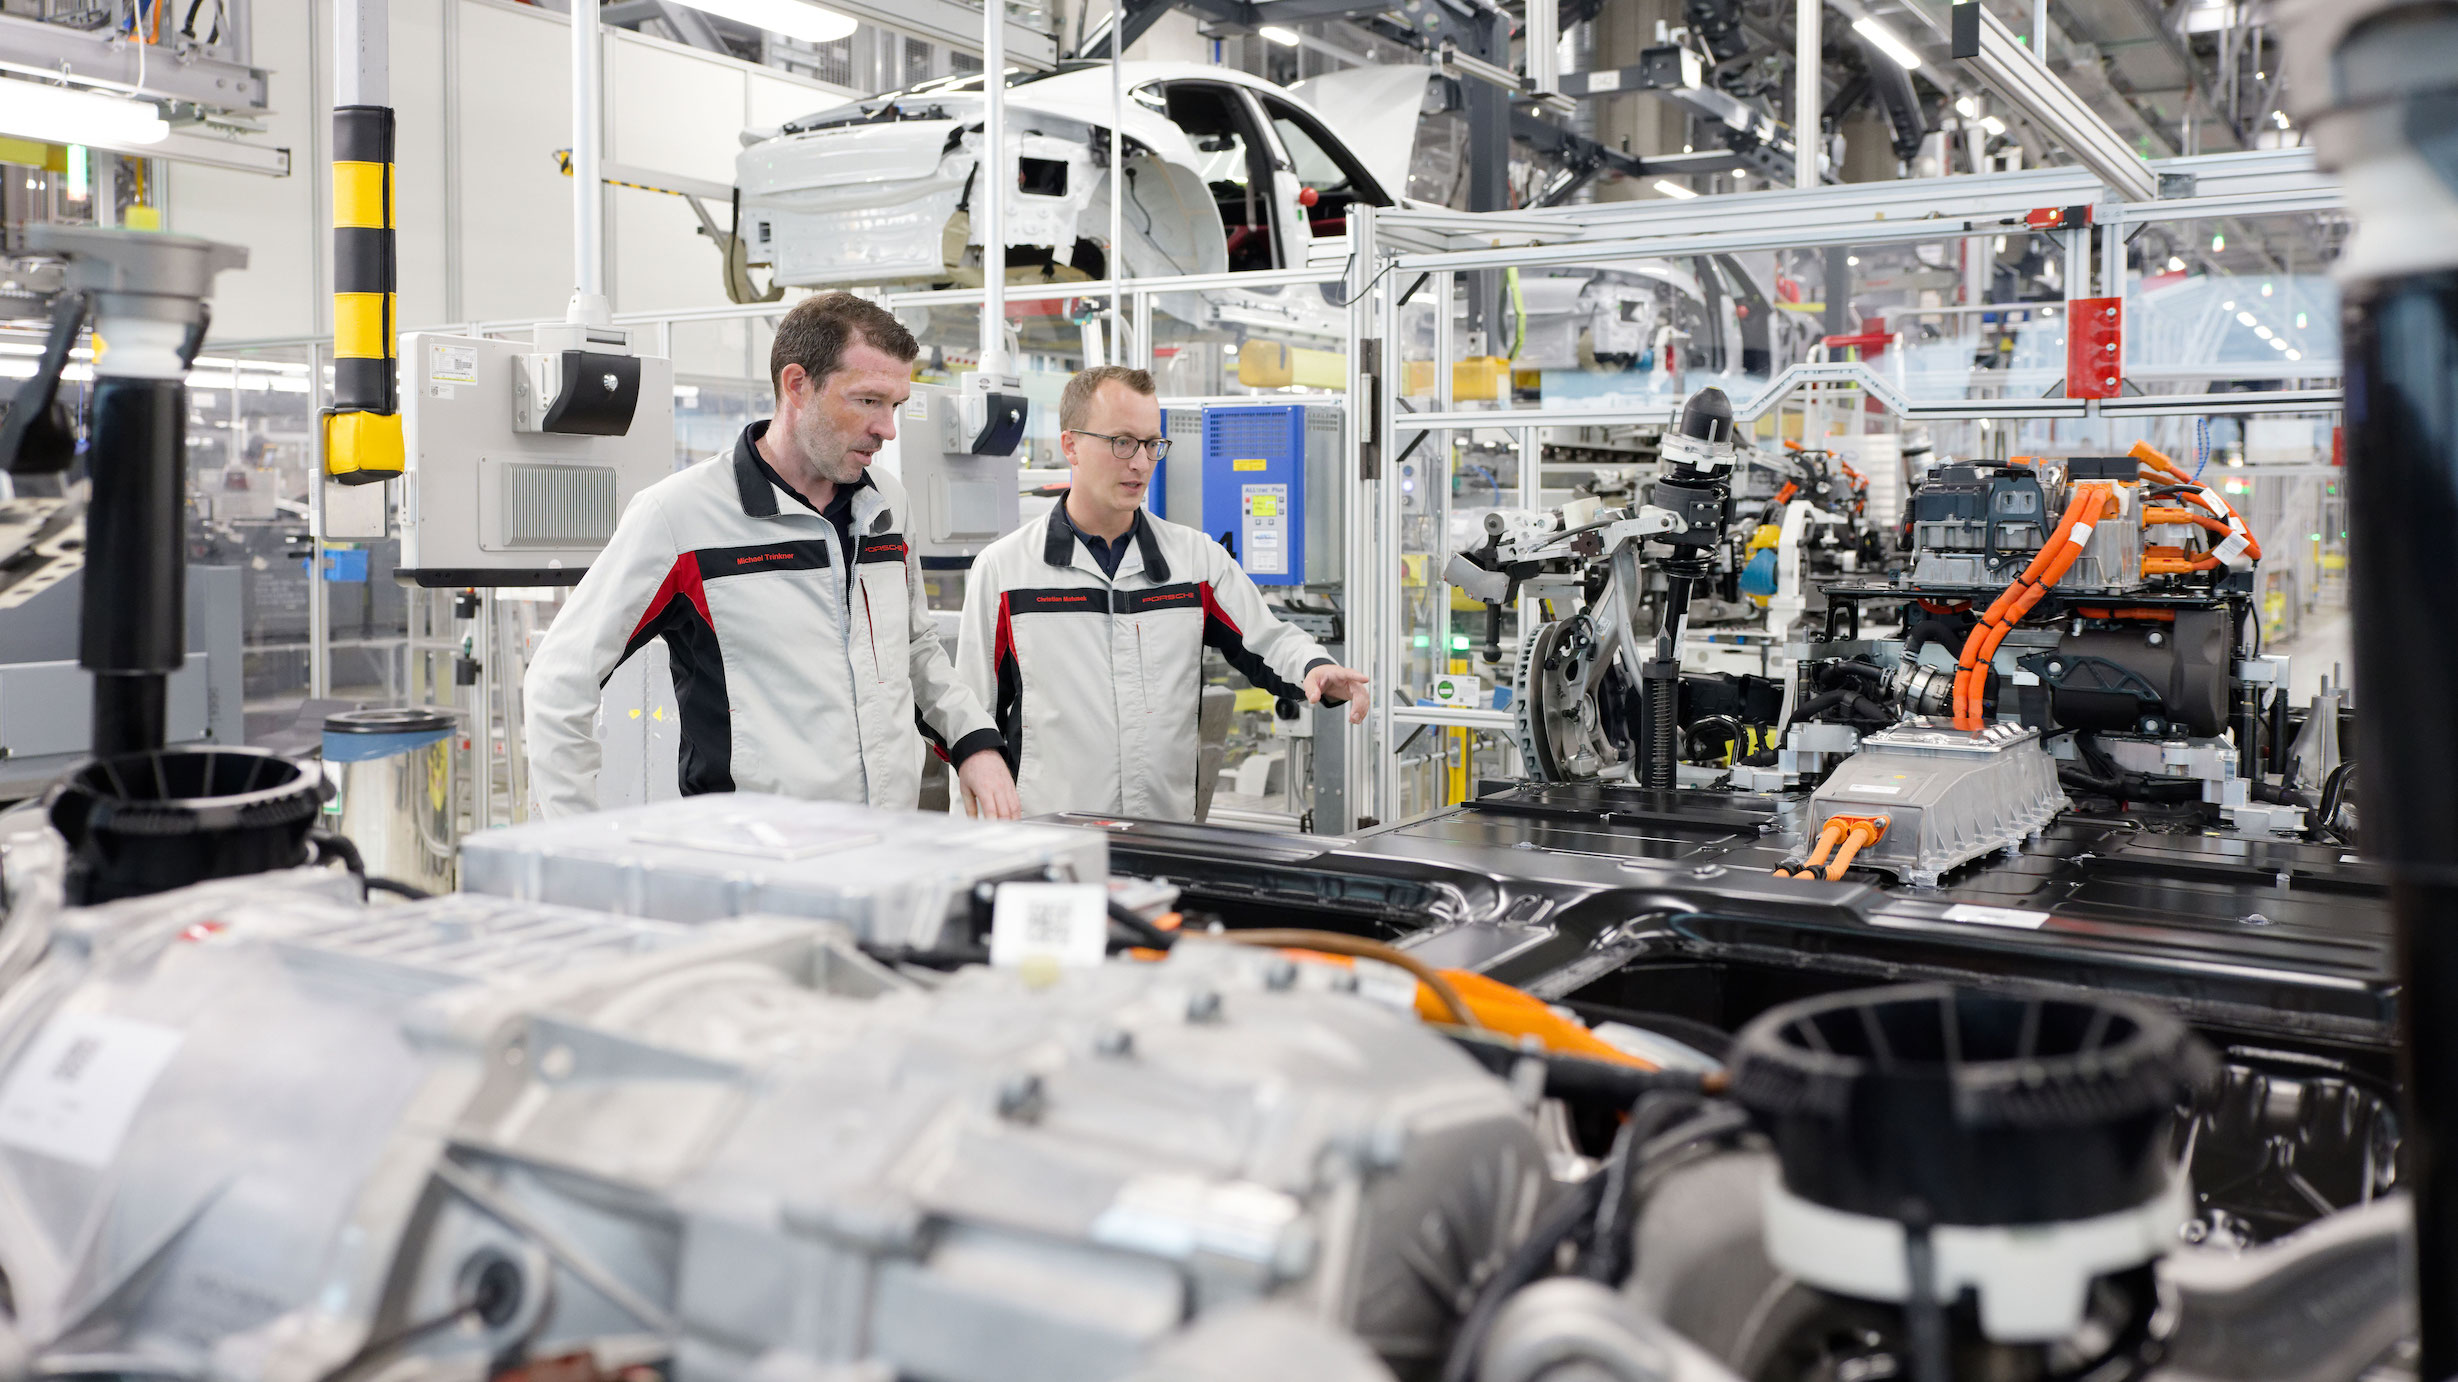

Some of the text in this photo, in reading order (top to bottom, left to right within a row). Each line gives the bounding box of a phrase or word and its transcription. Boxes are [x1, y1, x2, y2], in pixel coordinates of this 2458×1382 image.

[736, 552, 794, 565] Michael Trinkner
[1142, 592, 1194, 603] PORSCHE
